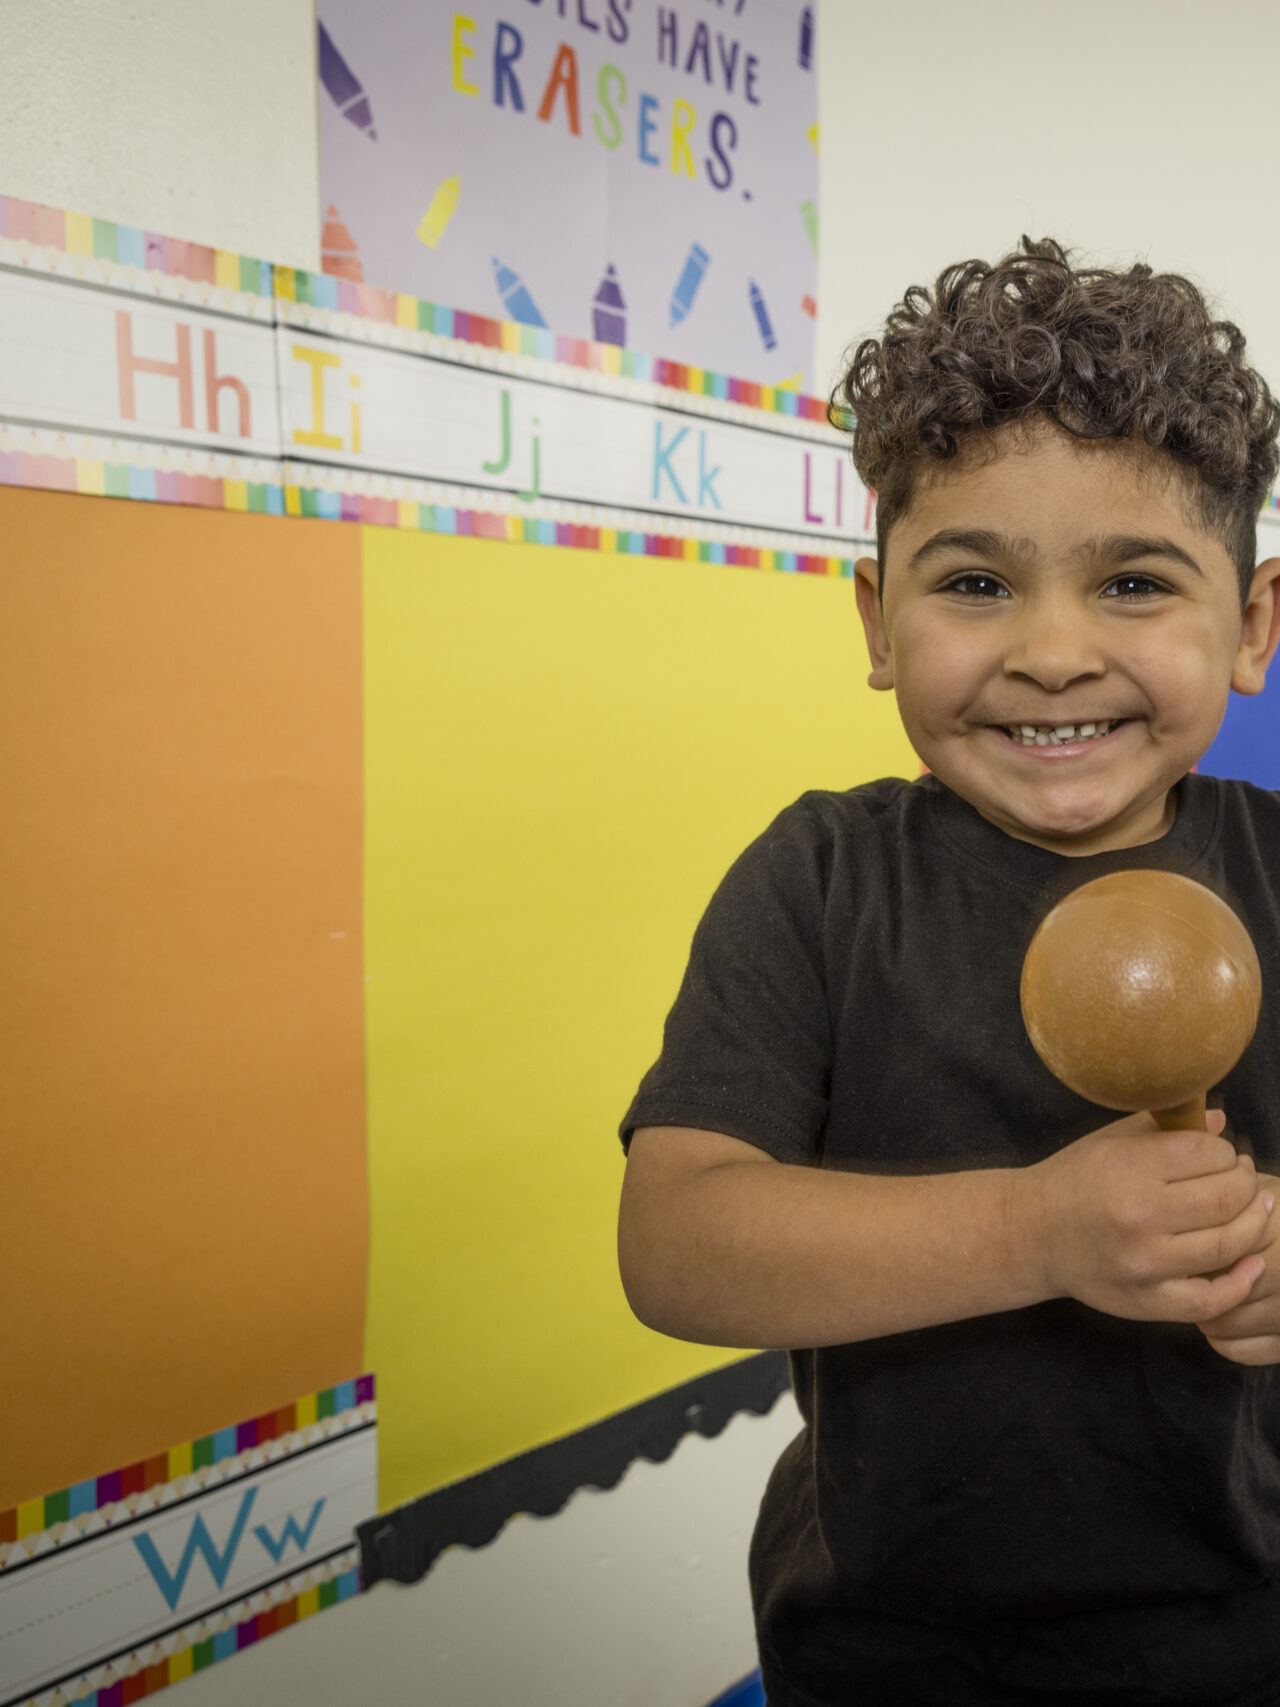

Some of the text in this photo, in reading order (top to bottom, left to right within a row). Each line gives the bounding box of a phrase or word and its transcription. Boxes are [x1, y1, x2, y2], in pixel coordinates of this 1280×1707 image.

[452, 12, 752, 201] ERASERS.
[657, 4, 760, 105] HAVE
[115, 311, 252, 439] Hh
[291, 345, 362, 454] Ii
[482, 389, 541, 502] Jj
[652, 419, 723, 510] Kk
[133, 1486, 326, 1613] Ww
